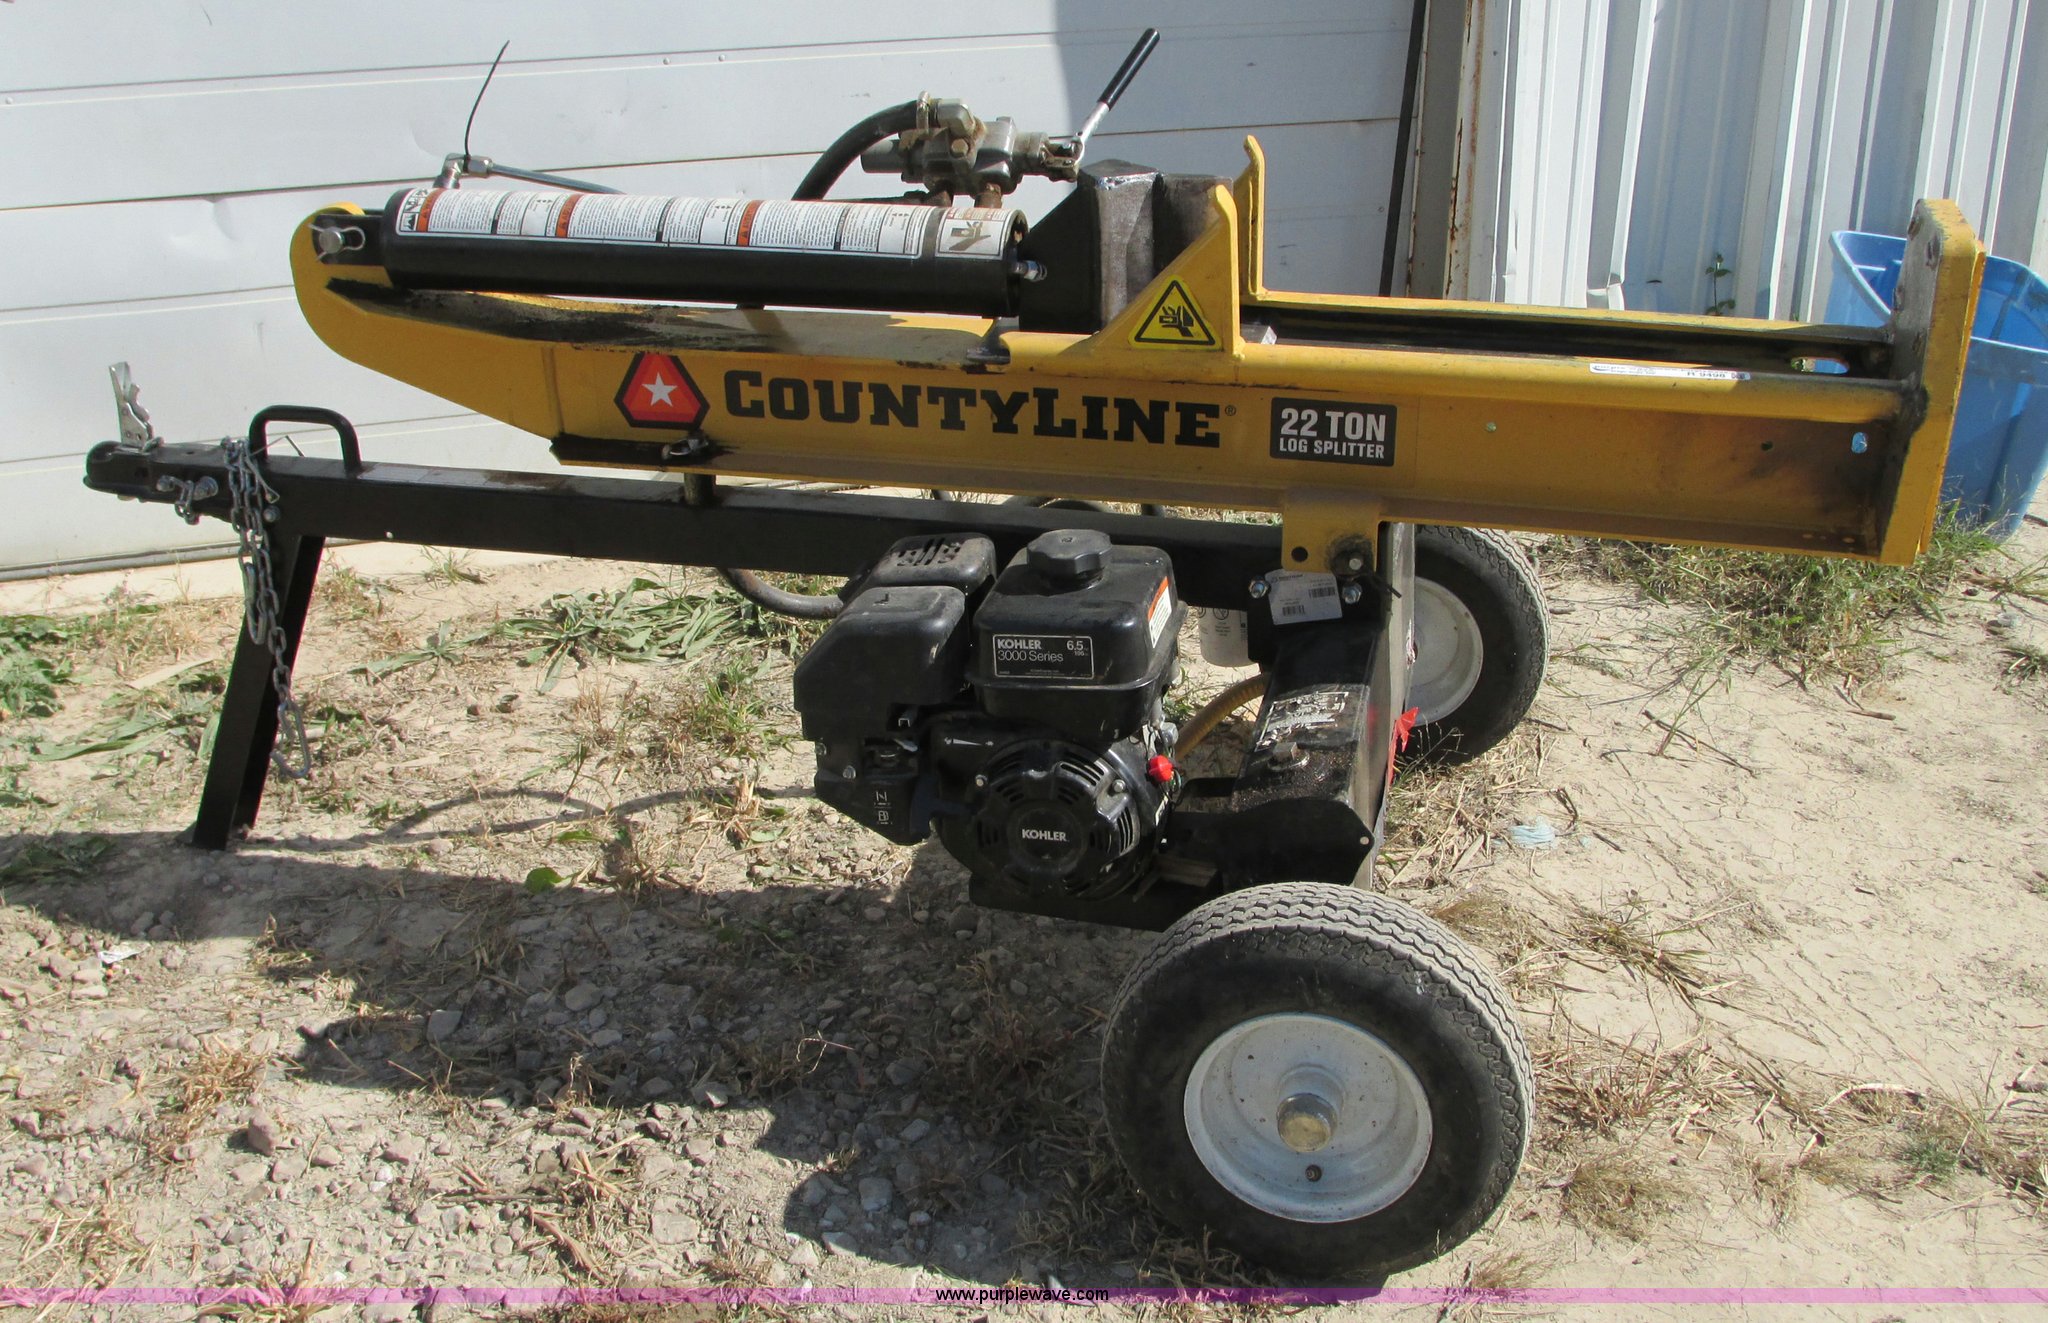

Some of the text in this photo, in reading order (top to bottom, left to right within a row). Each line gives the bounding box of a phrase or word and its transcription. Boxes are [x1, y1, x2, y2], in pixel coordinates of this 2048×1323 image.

[1281, 408, 1386, 442] 22 TON
[1280, 438, 1385, 459] LOG SPLITTER
[997, 639, 1084, 651] KOHLER 6.5
[998, 650, 1027, 661] 3000
[1028, 650, 1064, 662] Series
[1021, 828, 1068, 842] KOHLER
